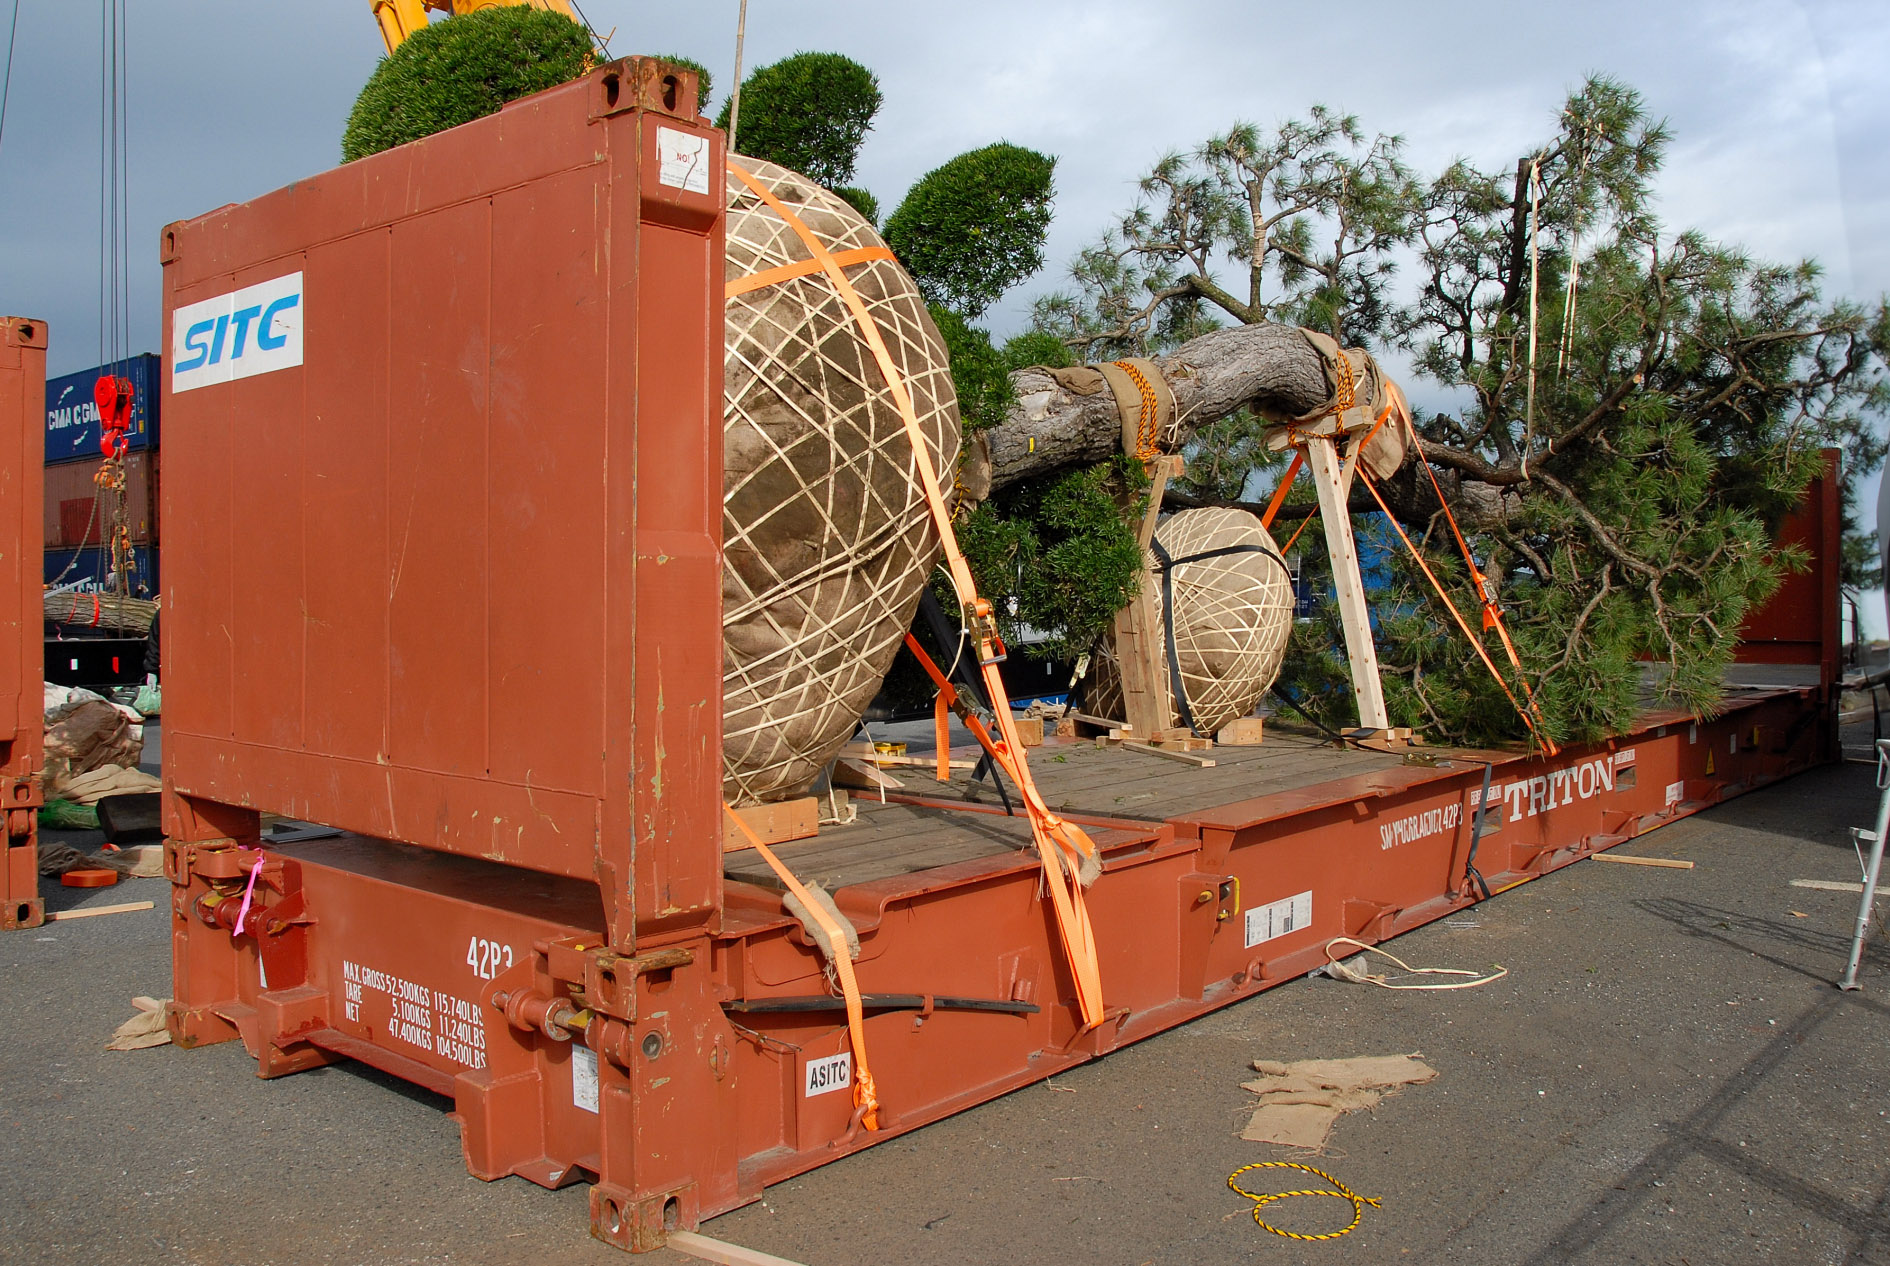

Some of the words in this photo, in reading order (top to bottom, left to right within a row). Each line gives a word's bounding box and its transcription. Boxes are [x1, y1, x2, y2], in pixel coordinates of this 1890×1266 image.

[174, 293, 300, 374] SITC
[48, 407, 72, 430] CMA
[1504, 756, 1613, 823] TRITON
[344, 980, 363, 1004] TARE
[345, 1000, 360, 1023] NET
[809, 1060, 846, 1090] ASITC
